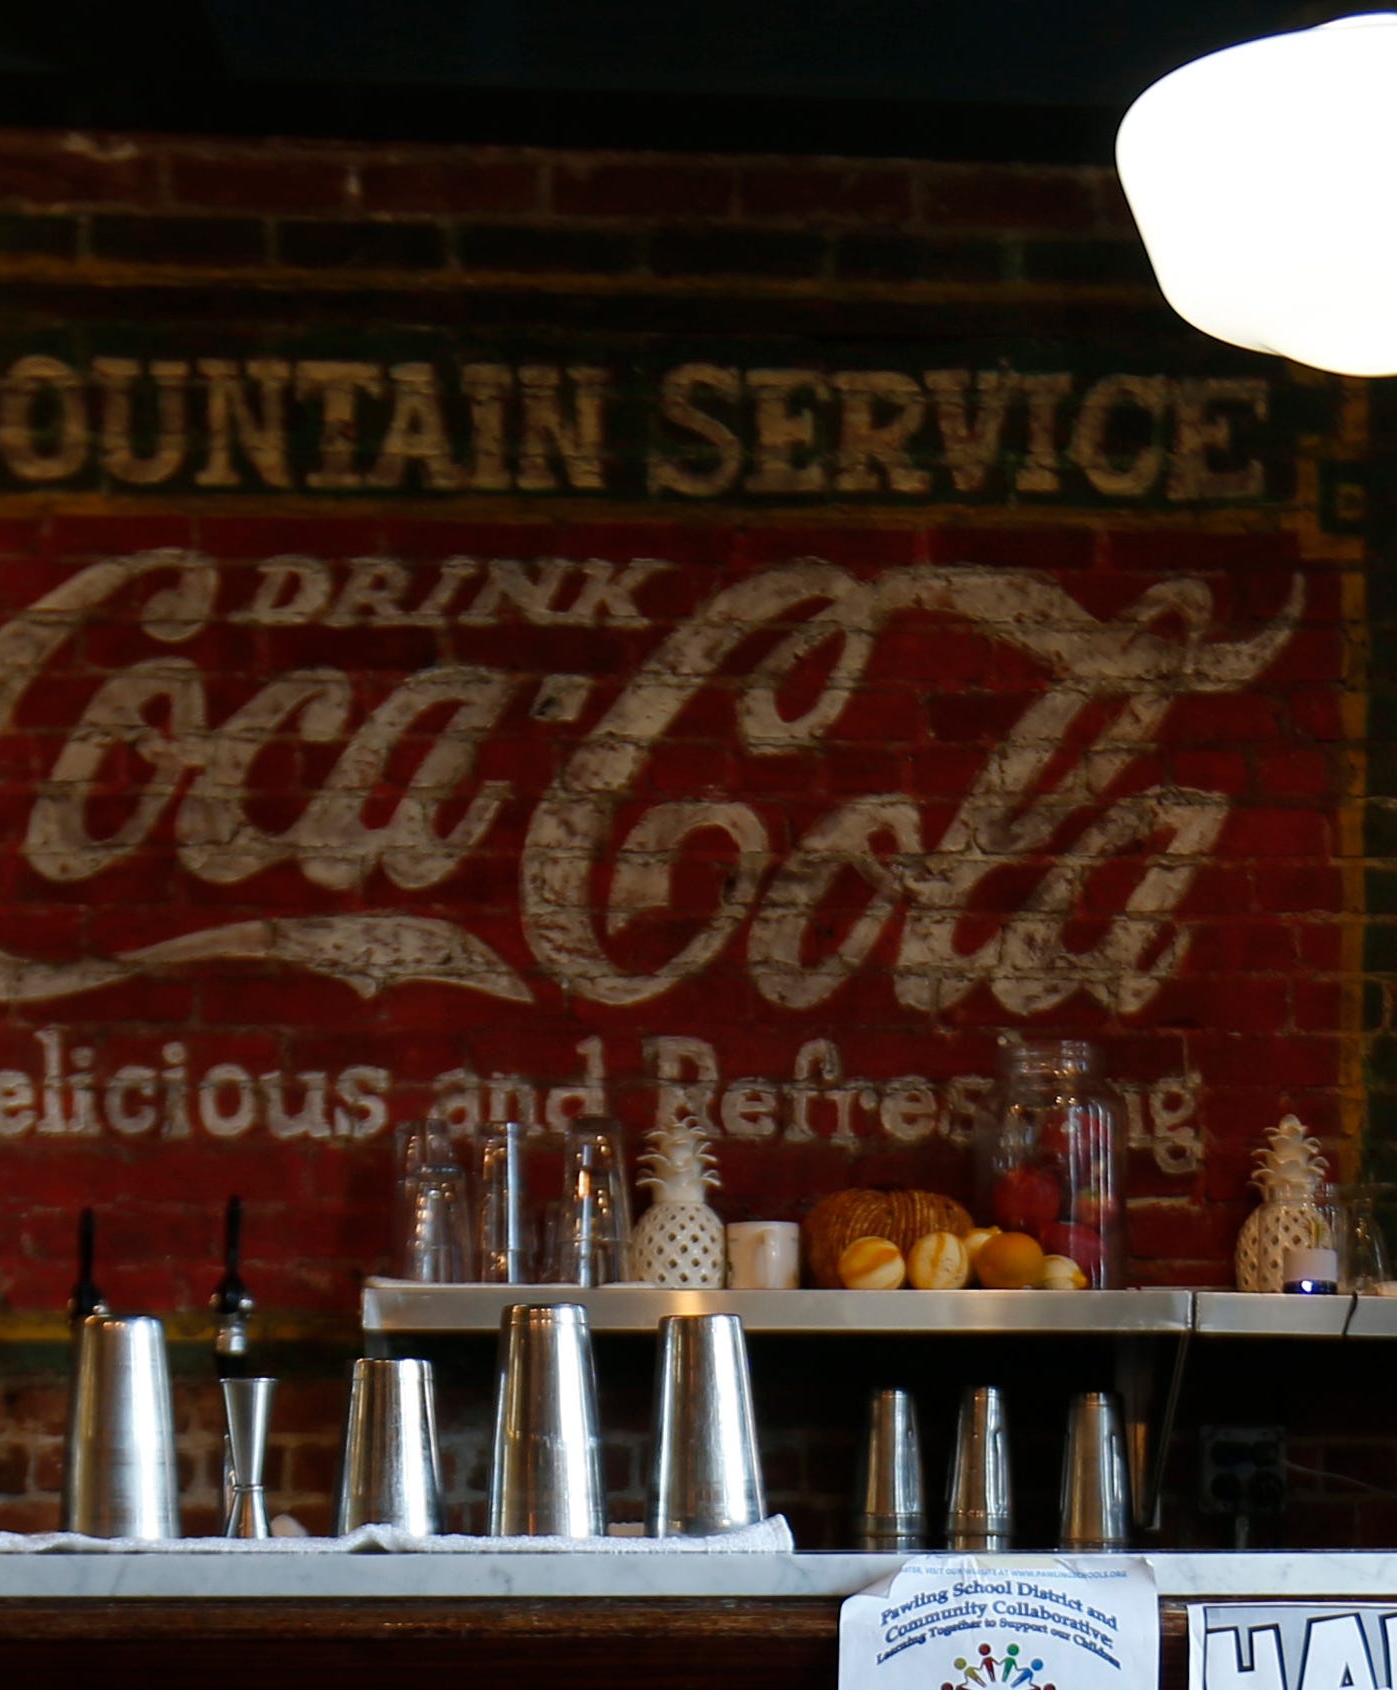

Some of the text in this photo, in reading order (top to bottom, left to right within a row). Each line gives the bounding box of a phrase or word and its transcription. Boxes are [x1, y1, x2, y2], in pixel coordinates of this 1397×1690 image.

[647, 364, 1269, 502] SERVICE
[226, 556, 684, 630] DRINK
[428, 1034, 607, 1138] and
[643, 1030, 1209, 1175] Refresng
[880, 1580, 1119, 1632] Pawling School District and
[885, 1601, 987, 1645] Community
[876, 1631, 927, 1666] Learning
[929, 1618, 982, 1638] Together
[984, 1617, 997, 1629] to
[999, 1617, 1048, 1635] Support
[1050, 1626, 1071, 1642] our
